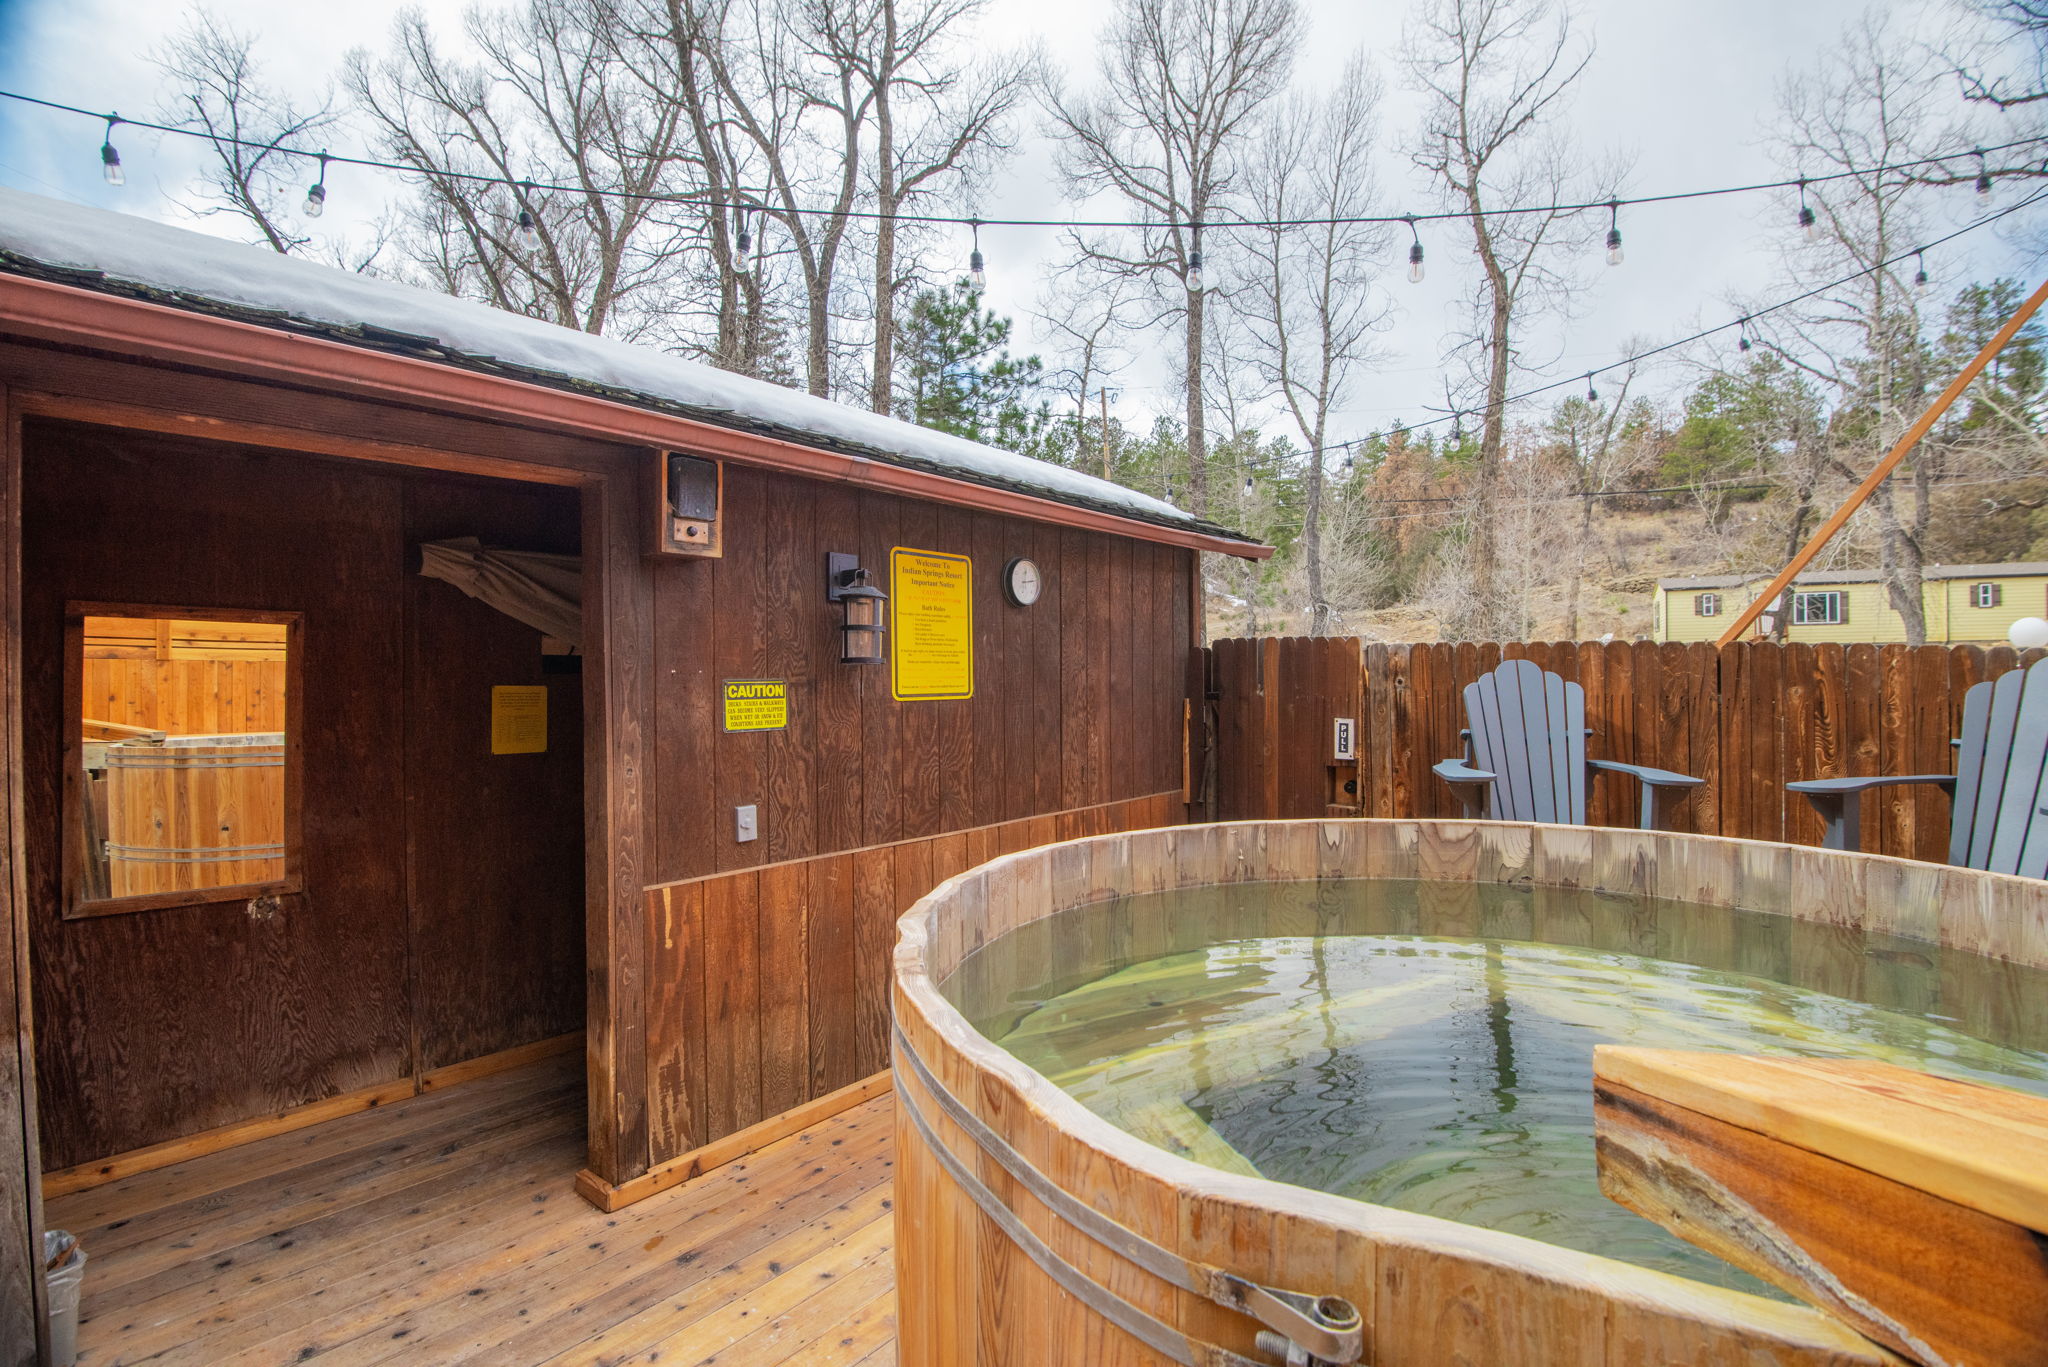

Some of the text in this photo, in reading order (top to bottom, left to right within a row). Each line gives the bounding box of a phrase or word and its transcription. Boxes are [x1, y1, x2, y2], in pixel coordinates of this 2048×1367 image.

[916, 559, 941, 568] Welcome
[902, 566, 963, 579] Indian Springs Resort
[911, 578, 938, 587] Important
[728, 685, 784, 698] CAUTION
